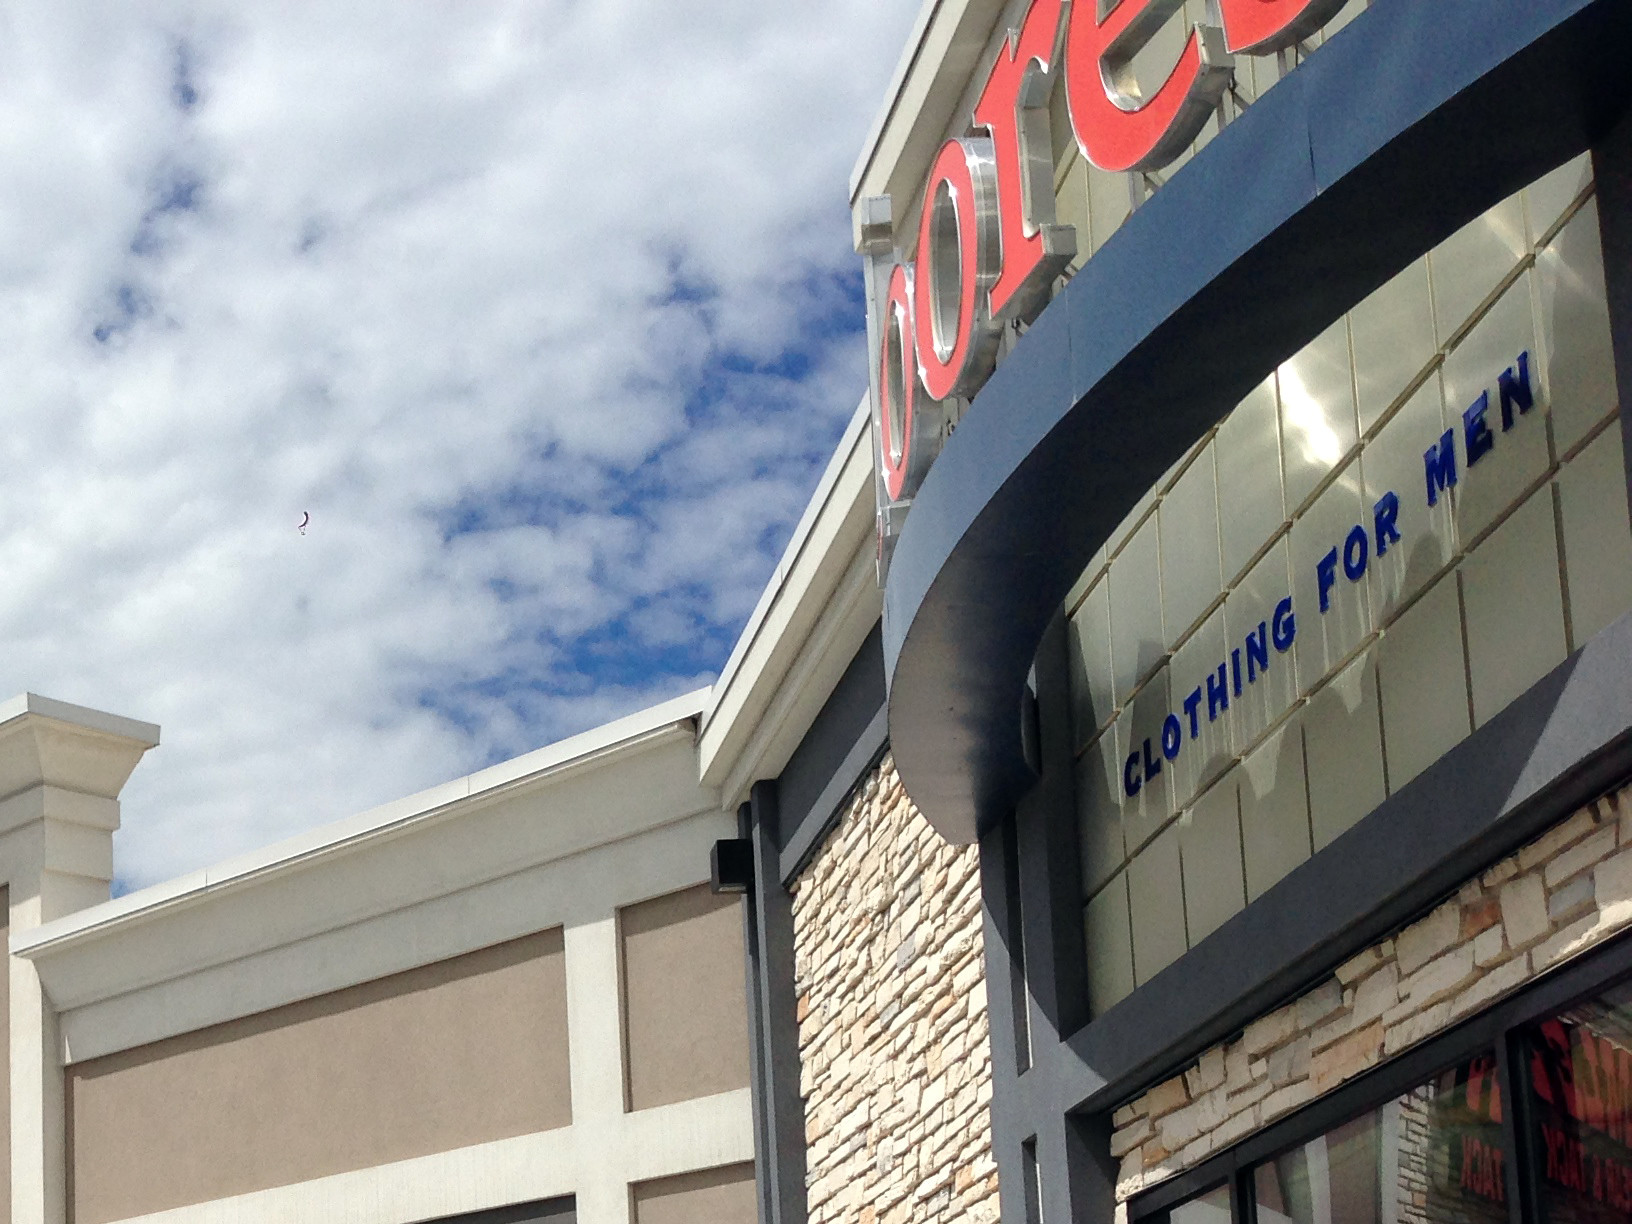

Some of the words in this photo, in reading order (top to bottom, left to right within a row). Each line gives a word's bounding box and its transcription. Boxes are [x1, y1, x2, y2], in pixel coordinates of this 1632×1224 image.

[876, 0, 1334, 545] oore
[1124, 596, 1297, 798] CLOTHING
[1316, 490, 1401, 614] FOR
[1423, 350, 1535, 507] MEN
